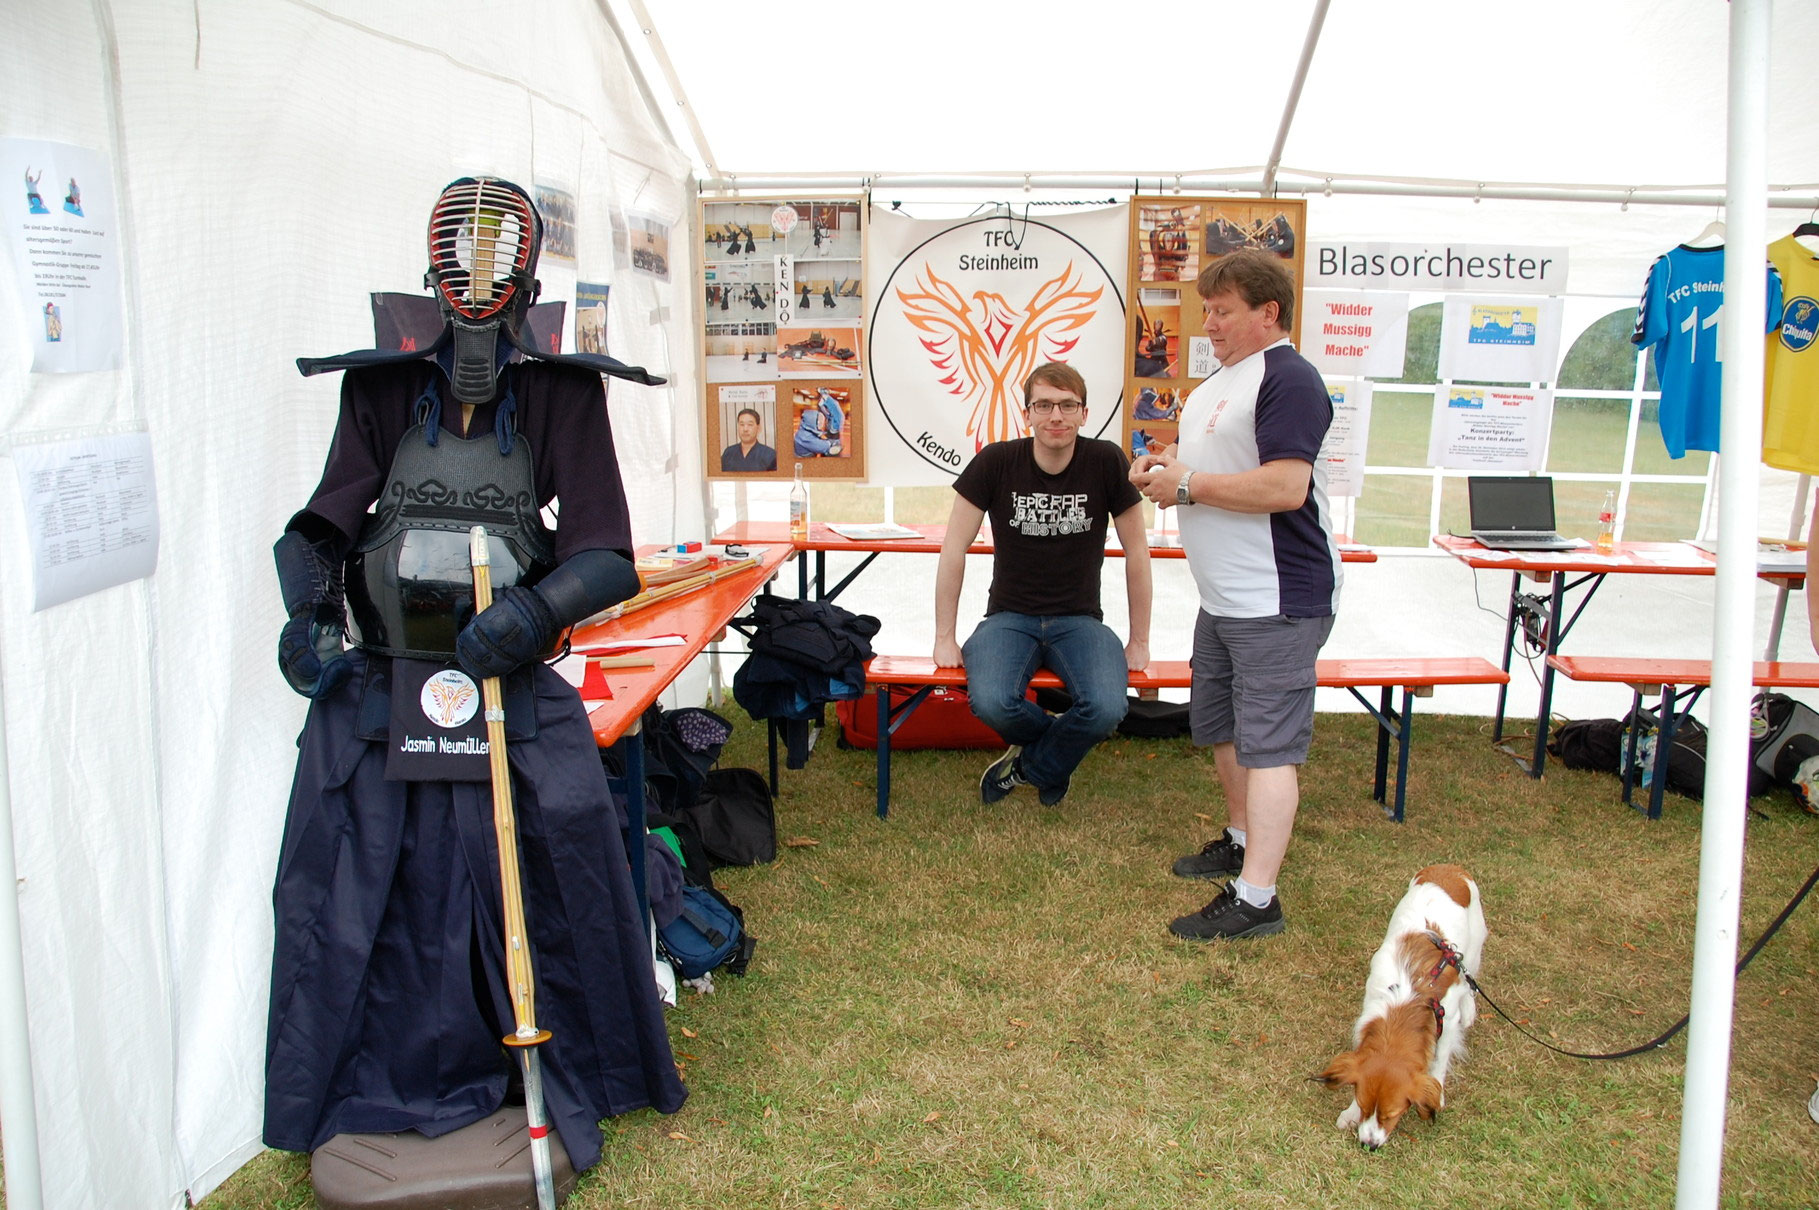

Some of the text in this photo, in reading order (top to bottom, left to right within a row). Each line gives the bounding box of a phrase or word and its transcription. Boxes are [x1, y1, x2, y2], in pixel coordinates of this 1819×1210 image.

[984, 230, 1014, 247] TFC
[958, 254, 1038, 270] Steinheim
[1319, 245, 1553, 280] Blasorchester
[1668, 285, 1690, 304] TFC
[1326, 302, 1373, 317] "Widder
[1323, 323, 1372, 338] Mussigg
[1680, 304, 1724, 364] 11
[1782, 324, 1813, 341] Chiquita
[1325, 344, 1370, 357] Mache"
[1470, 428, 1514, 436] Konzertparty:
[916, 431, 962, 466] Kendo
[1018, 493, 1088, 510] EPIC RAP
[1014, 507, 1086, 522] BATTLES
[1008, 518, 1094, 536] OF HISTORY
[400, 735, 490, 754] Jasmin Neumüller
